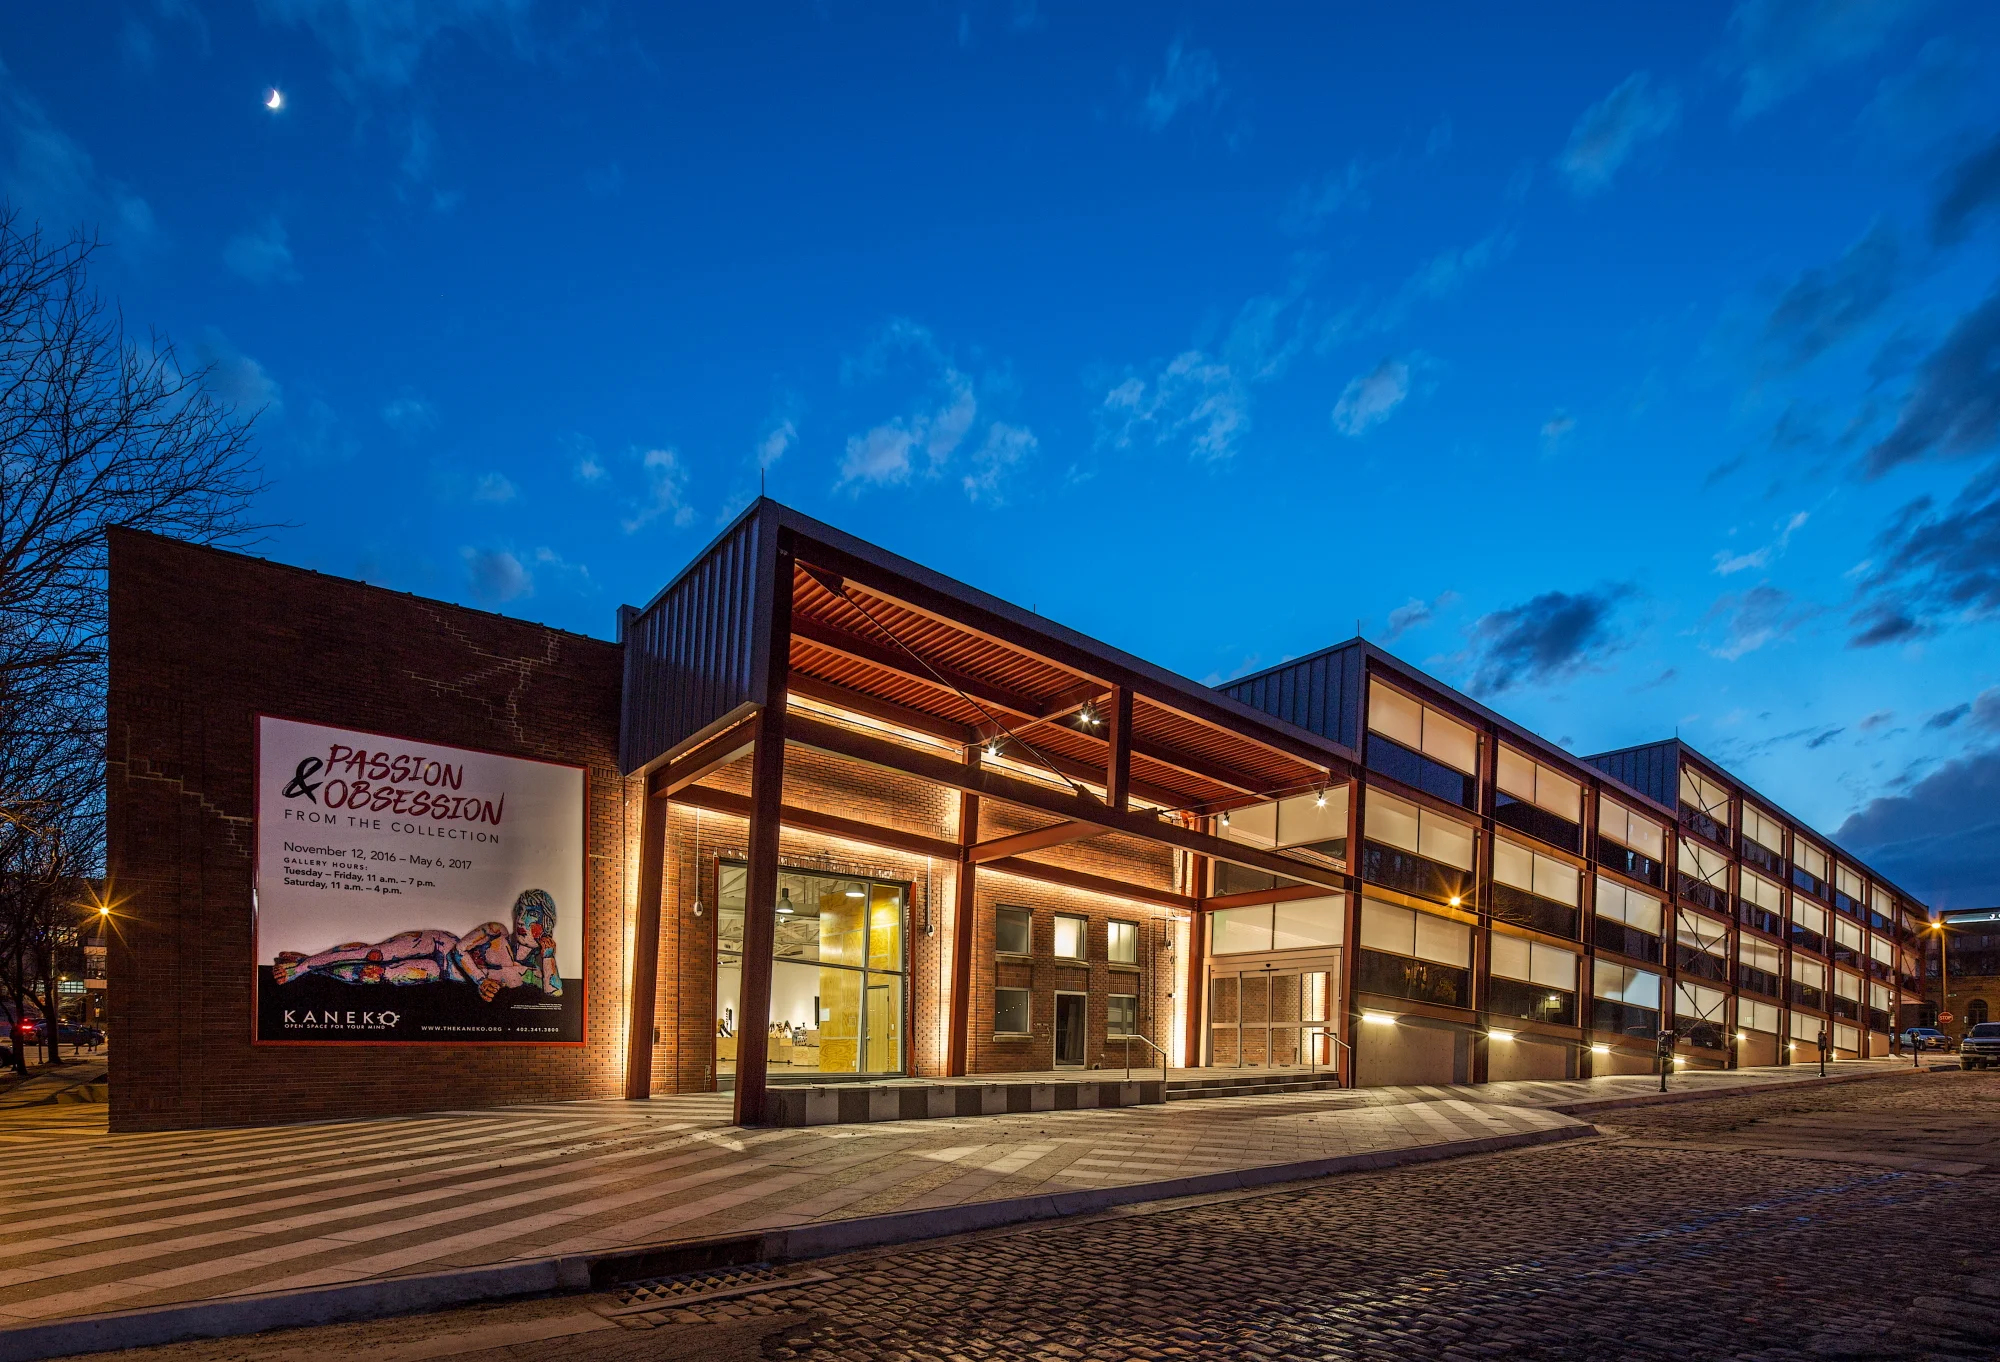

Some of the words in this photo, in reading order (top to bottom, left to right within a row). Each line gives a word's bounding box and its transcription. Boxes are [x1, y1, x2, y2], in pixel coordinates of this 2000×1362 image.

[324, 744, 464, 790] PASSION
[281, 756, 323, 804] &
[324, 779, 505, 825] OBSESSION
[284, 809, 337, 825] FROM
[347, 816, 381, 830] THE
[391, 822, 500, 844] COLLECTION
[283, 857, 327, 867] GALLERY
[332, 862, 368, 871] HOURS:
[284, 841, 347, 857] November
[351, 849, 367, 861] 12,
[370, 850, 397, 862] 2016
[409, 855, 433, 868] May
[435, 858, 445, 868] 6,
[449, 859, 472, 870] 2017
[283, 866, 323, 878] Tuesday
[334, 871, 364, 882] Friday,
[379, 876, 398, 884] a.m.
[408, 877, 415, 885] 7
[416, 880, 435, 888] p.m.
[283, 877, 328, 889] Saturday,
[382, 887, 402, 895] p.m.
[284, 1010, 400, 1027] KANEKO
